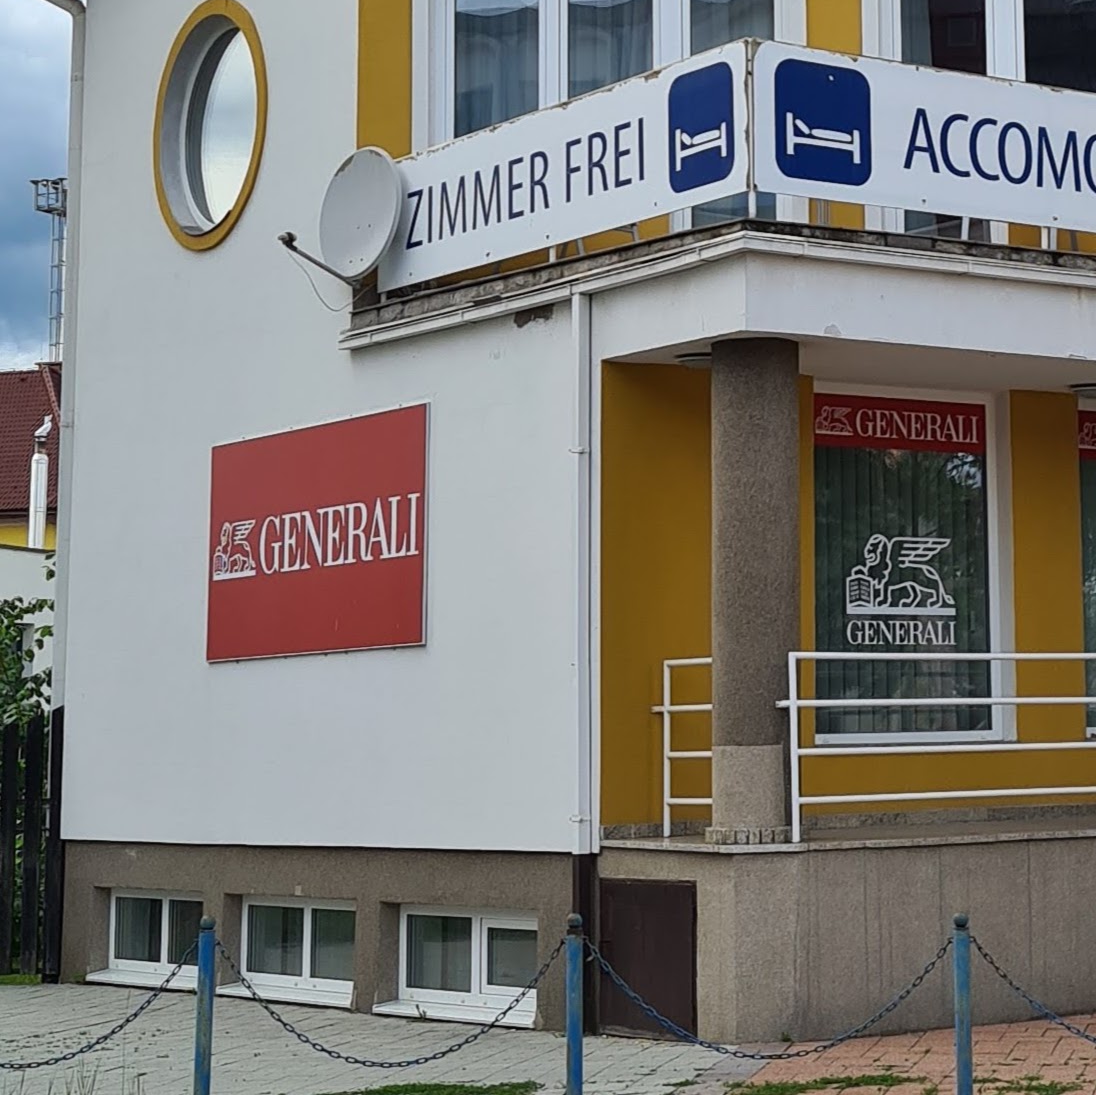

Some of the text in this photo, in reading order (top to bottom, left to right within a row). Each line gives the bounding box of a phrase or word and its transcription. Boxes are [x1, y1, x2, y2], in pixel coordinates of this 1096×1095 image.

[405, 117, 645, 251] ZIMMER FREI
[855, 408, 979, 444] GENERALI
[259, 492, 420, 575] GENERALI
[846, 620, 957, 646] GENERALI
